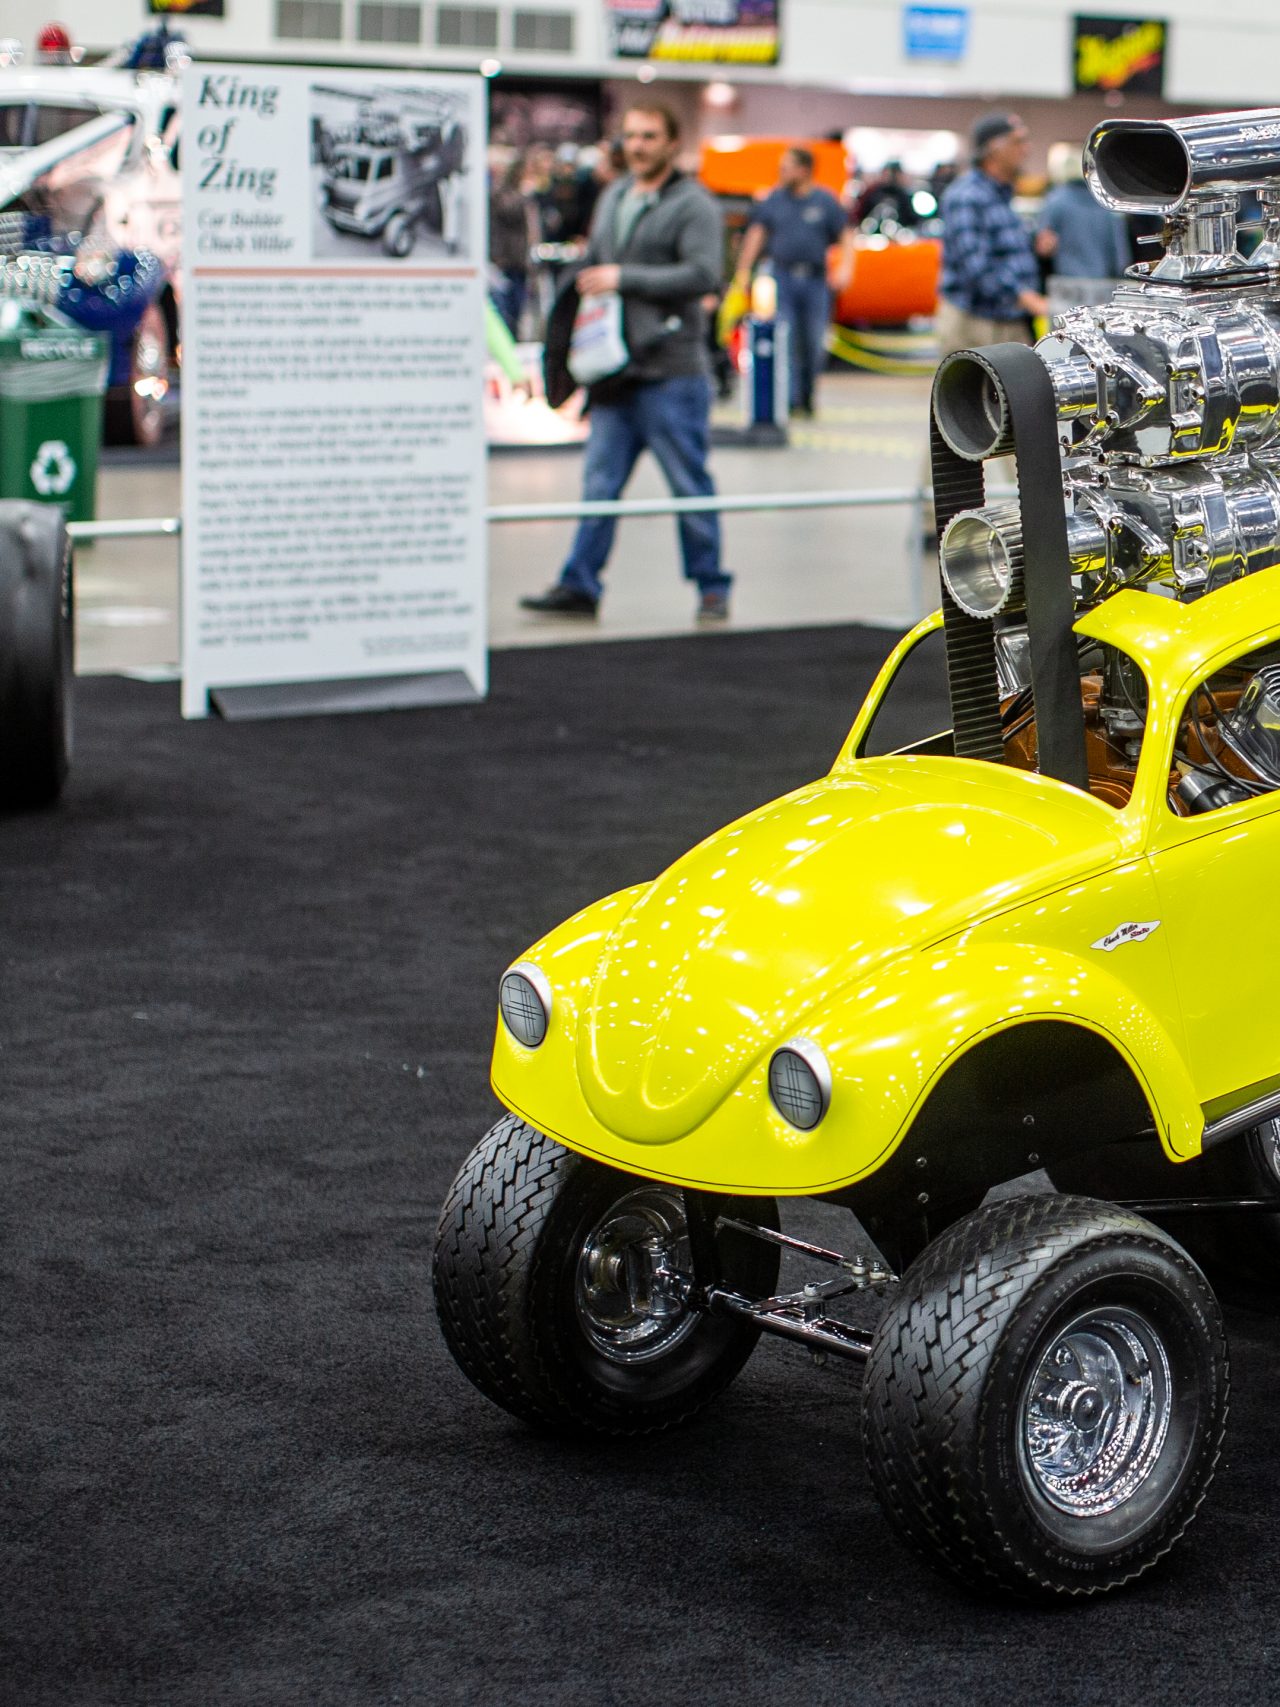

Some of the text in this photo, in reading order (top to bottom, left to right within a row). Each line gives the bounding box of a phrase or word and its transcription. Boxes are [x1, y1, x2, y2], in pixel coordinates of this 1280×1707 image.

[199, 74, 280, 115] King
[197, 116, 238, 154] of
[199, 156, 277, 200] Zing
[1104, 932, 1120, 947] Chuck
